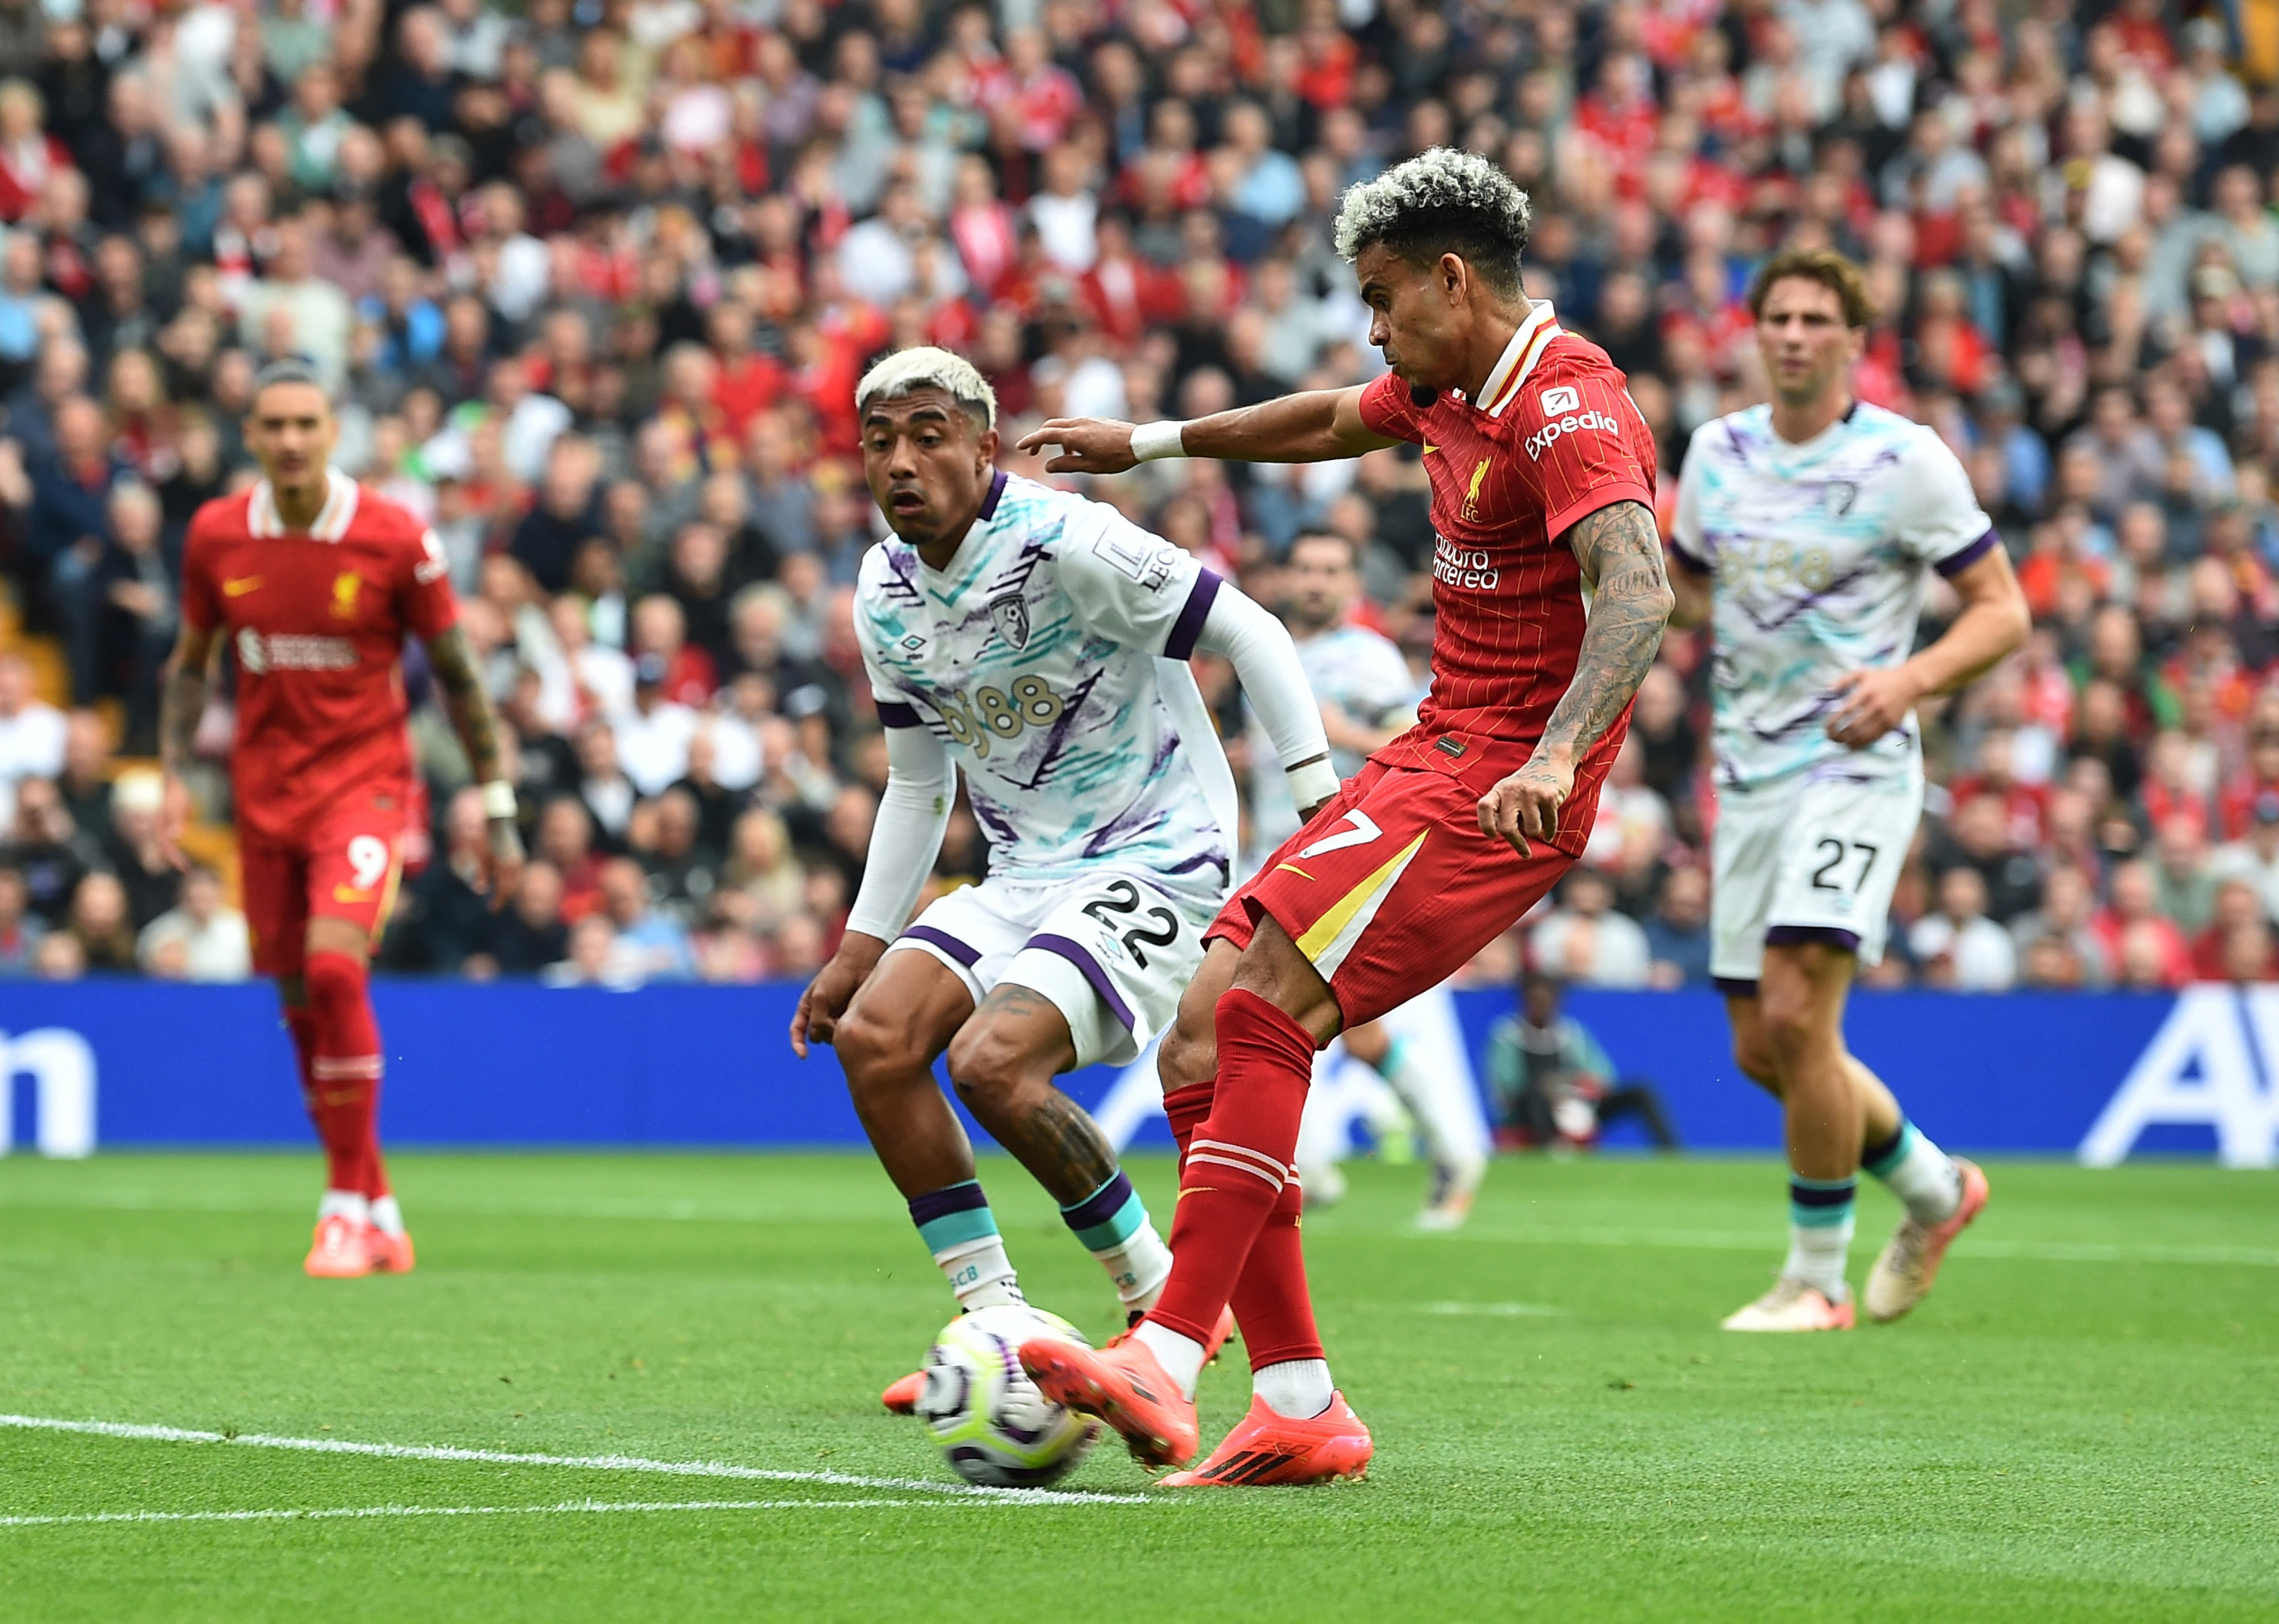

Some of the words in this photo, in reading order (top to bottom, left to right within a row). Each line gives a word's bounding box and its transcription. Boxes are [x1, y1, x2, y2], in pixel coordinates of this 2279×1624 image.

[1525, 410, 1618, 462] Expedia
[1140, 548, 1175, 593] LEO
[929, 674, 1064, 759] bj88
[1297, 807, 1383, 859] 7
[347, 834, 389, 891] 9
[1812, 838, 1877, 893] 27
[1081, 880, 1179, 970] 22
